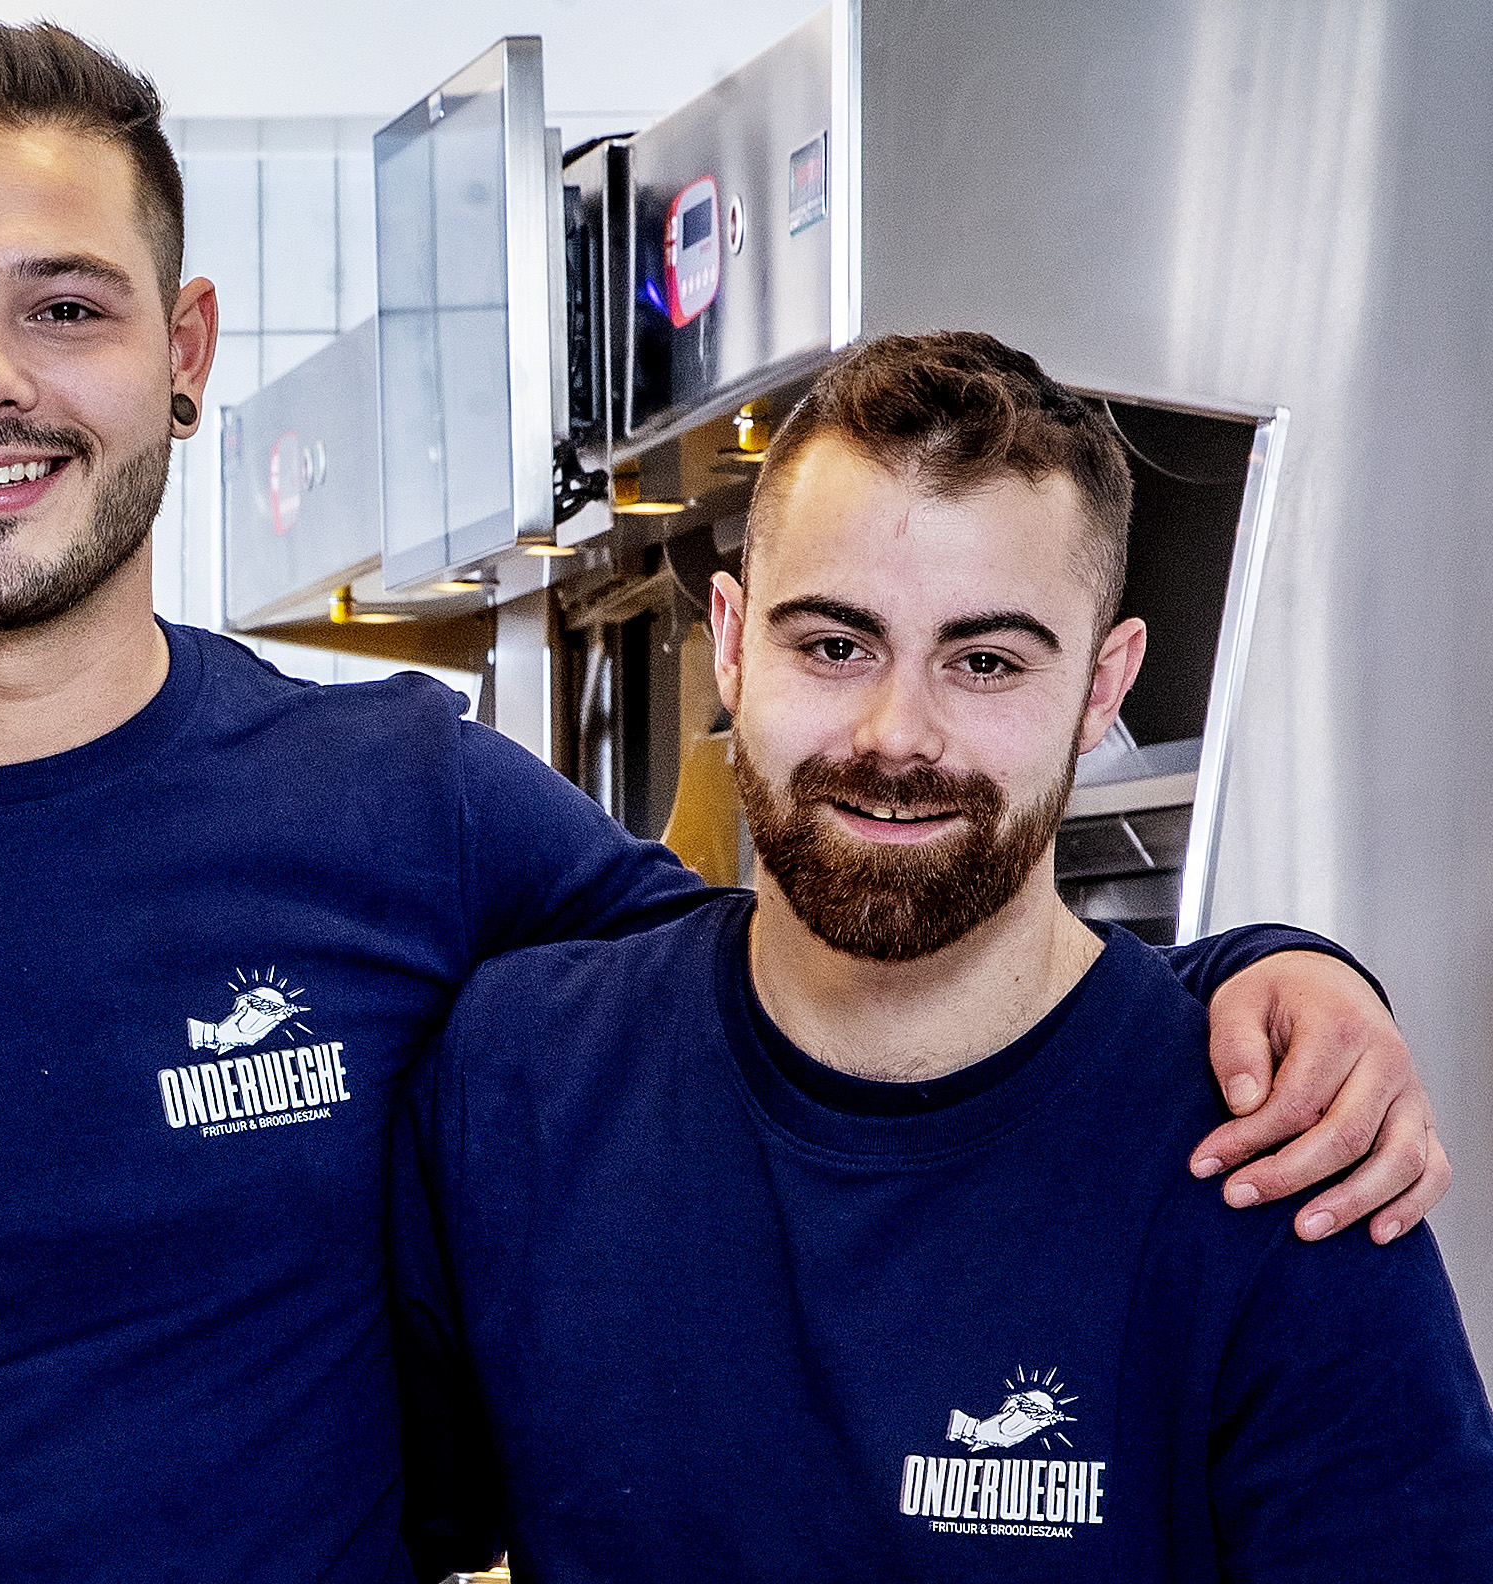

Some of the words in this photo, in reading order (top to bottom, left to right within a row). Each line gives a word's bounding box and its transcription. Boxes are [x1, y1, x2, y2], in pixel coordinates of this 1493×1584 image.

[159, 1041, 351, 1129] ONDERWEGHE
[202, 1121, 248, 1138] FRITUUR
[249, 1118, 257, 1130] &
[259, 1107, 332, 1130] BROODJESZAAK
[900, 1454, 1106, 1524] ONDERWEGHE
[931, 1521, 979, 1535] FRITUUR
[979, 1523, 988, 1535] &
[990, 1523, 1073, 1539] BROODJESZAAK
